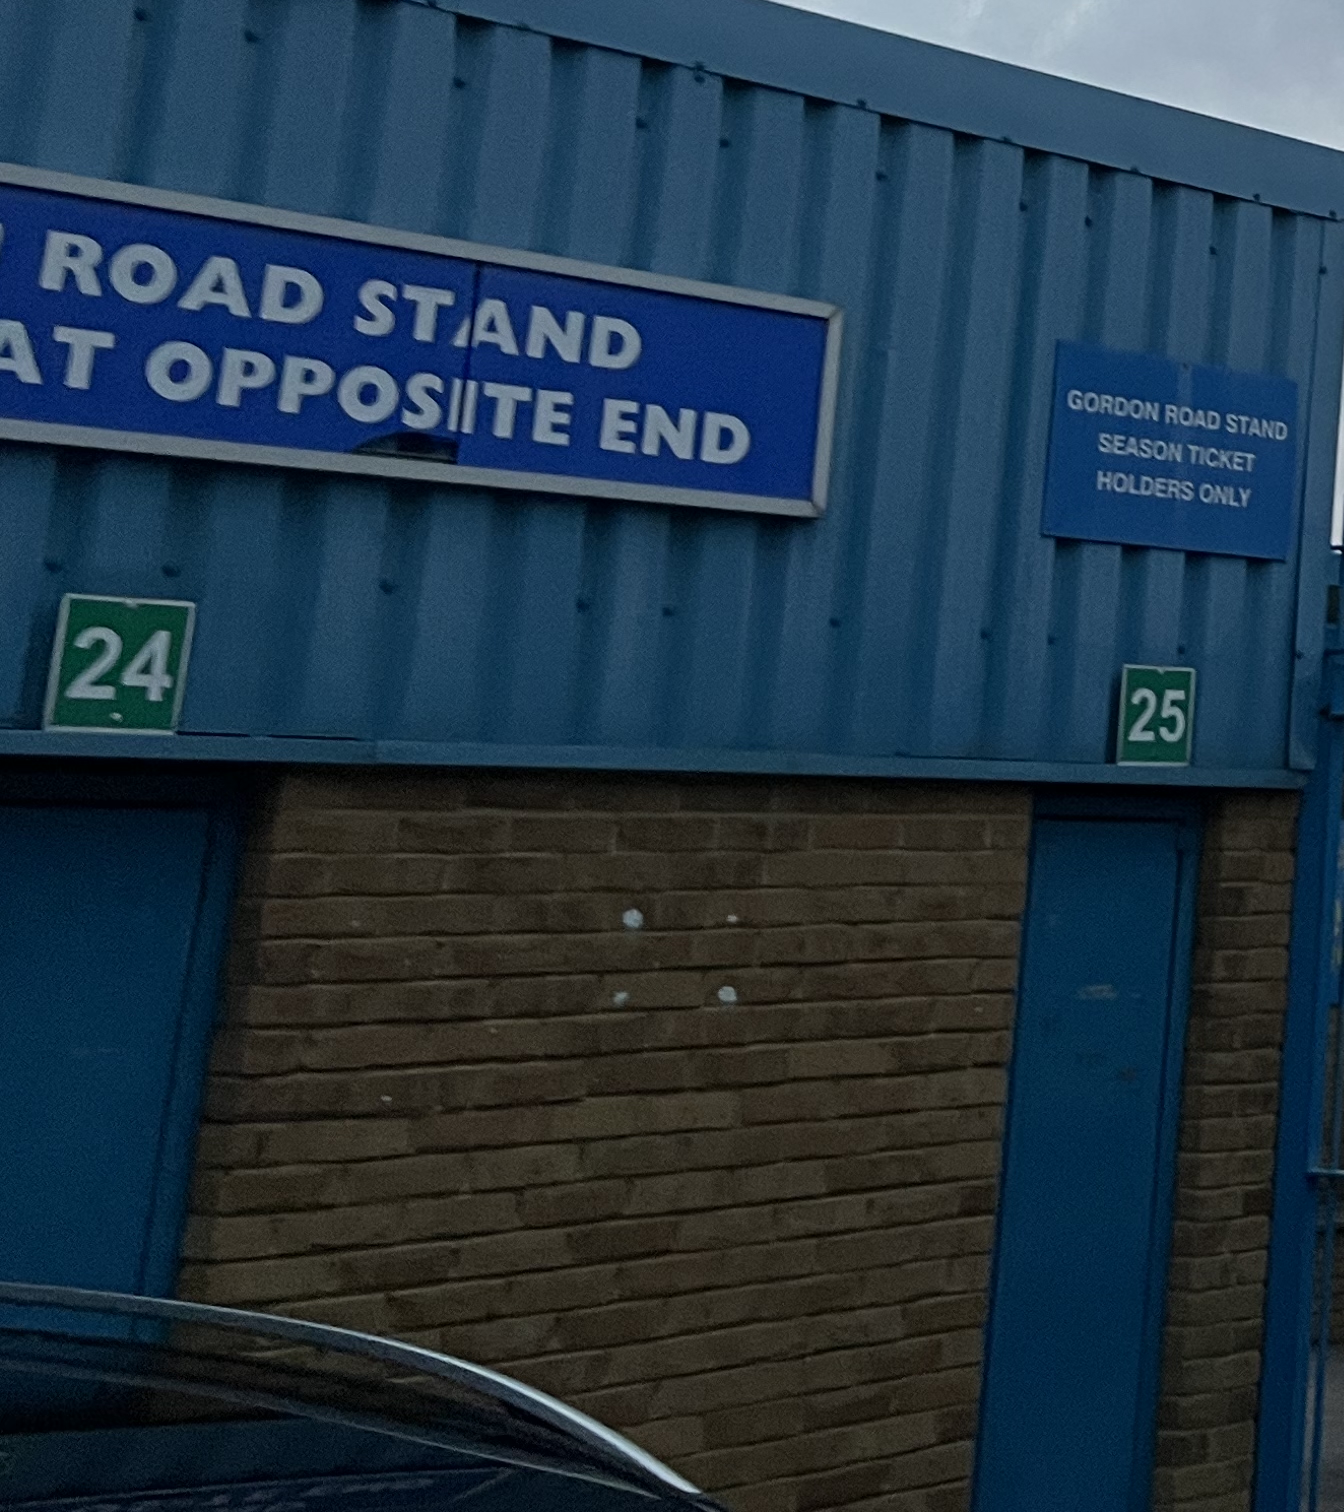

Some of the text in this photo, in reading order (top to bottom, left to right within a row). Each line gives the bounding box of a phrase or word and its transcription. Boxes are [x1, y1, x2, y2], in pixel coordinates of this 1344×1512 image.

[38, 229, 642, 370] ROAD STAND
[0, 319, 751, 465] AT OPPOSITE END
[1067, 389, 1288, 441] GORDON ROAD STAND
[1098, 432, 1256, 472] SEASON TICKET
[1096, 470, 1252, 508] HOLDERS ONLY
[64, 626, 174, 702] 24
[1128, 687, 1186, 743] 25
